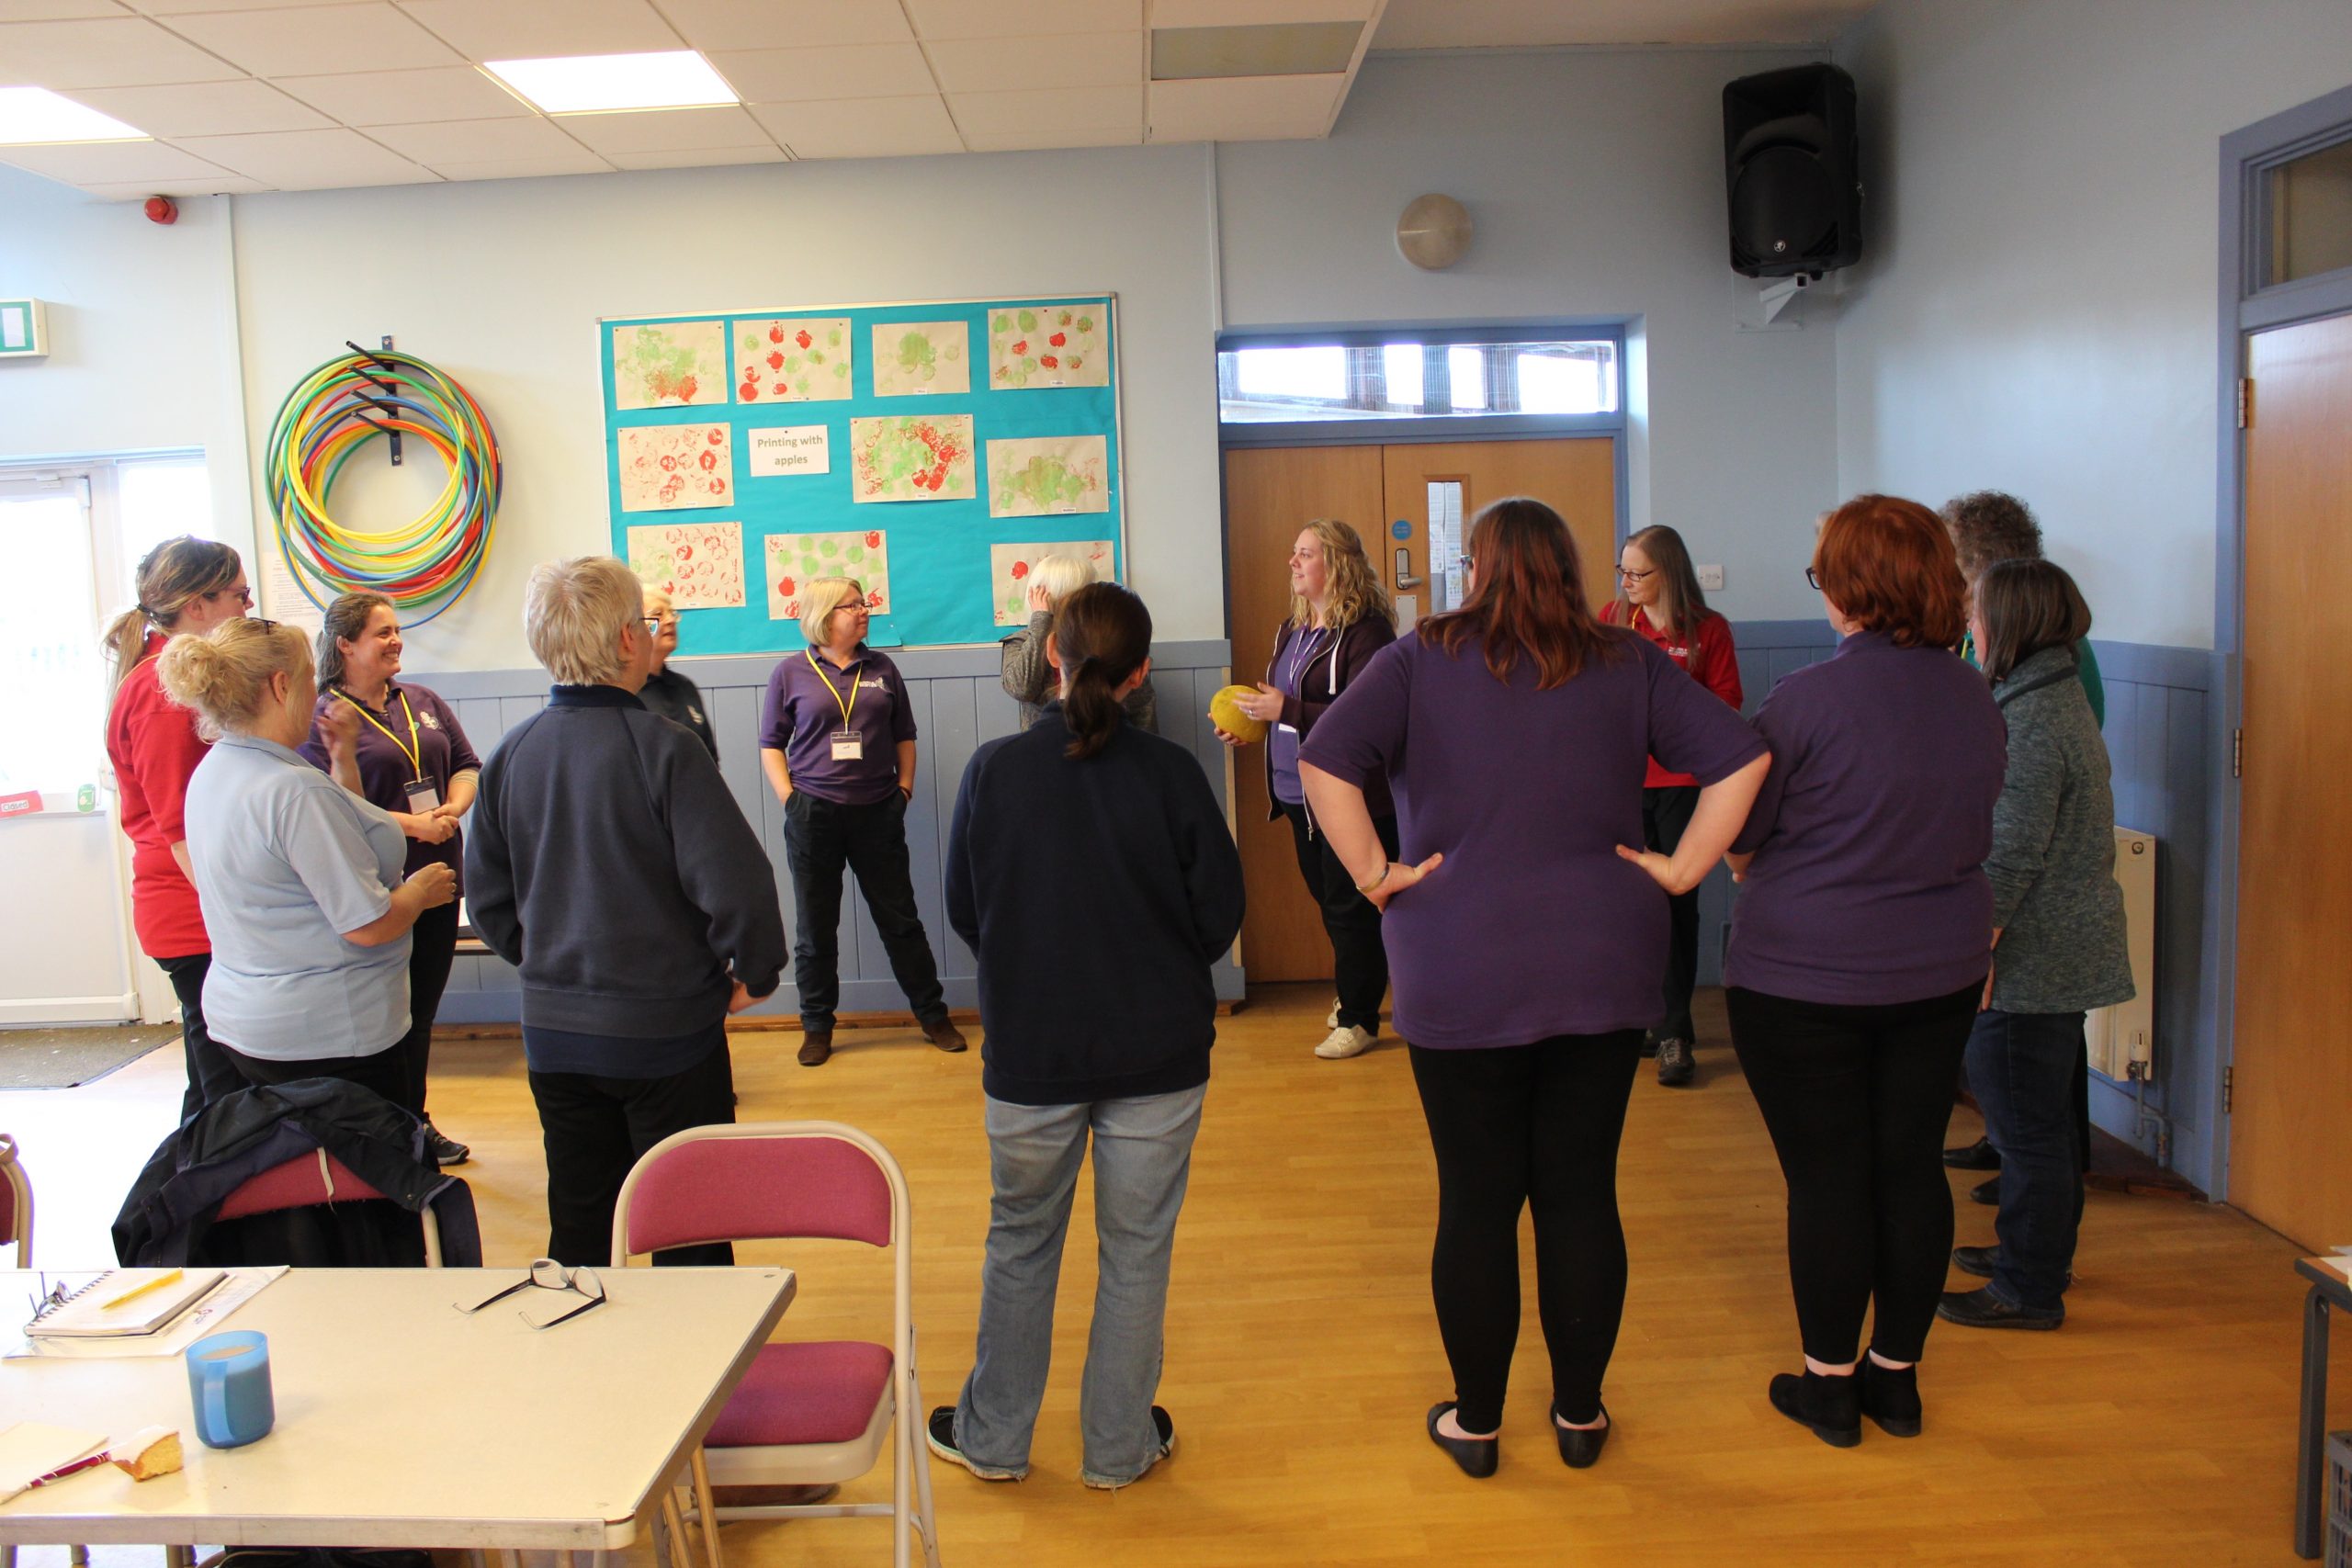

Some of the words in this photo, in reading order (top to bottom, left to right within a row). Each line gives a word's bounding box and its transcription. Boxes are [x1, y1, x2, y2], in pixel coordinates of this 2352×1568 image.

[757, 437, 797, 448] Printing
[799, 434, 823, 445] with
[775, 455, 808, 467] apples
[3, 801, 28, 810] Closed
